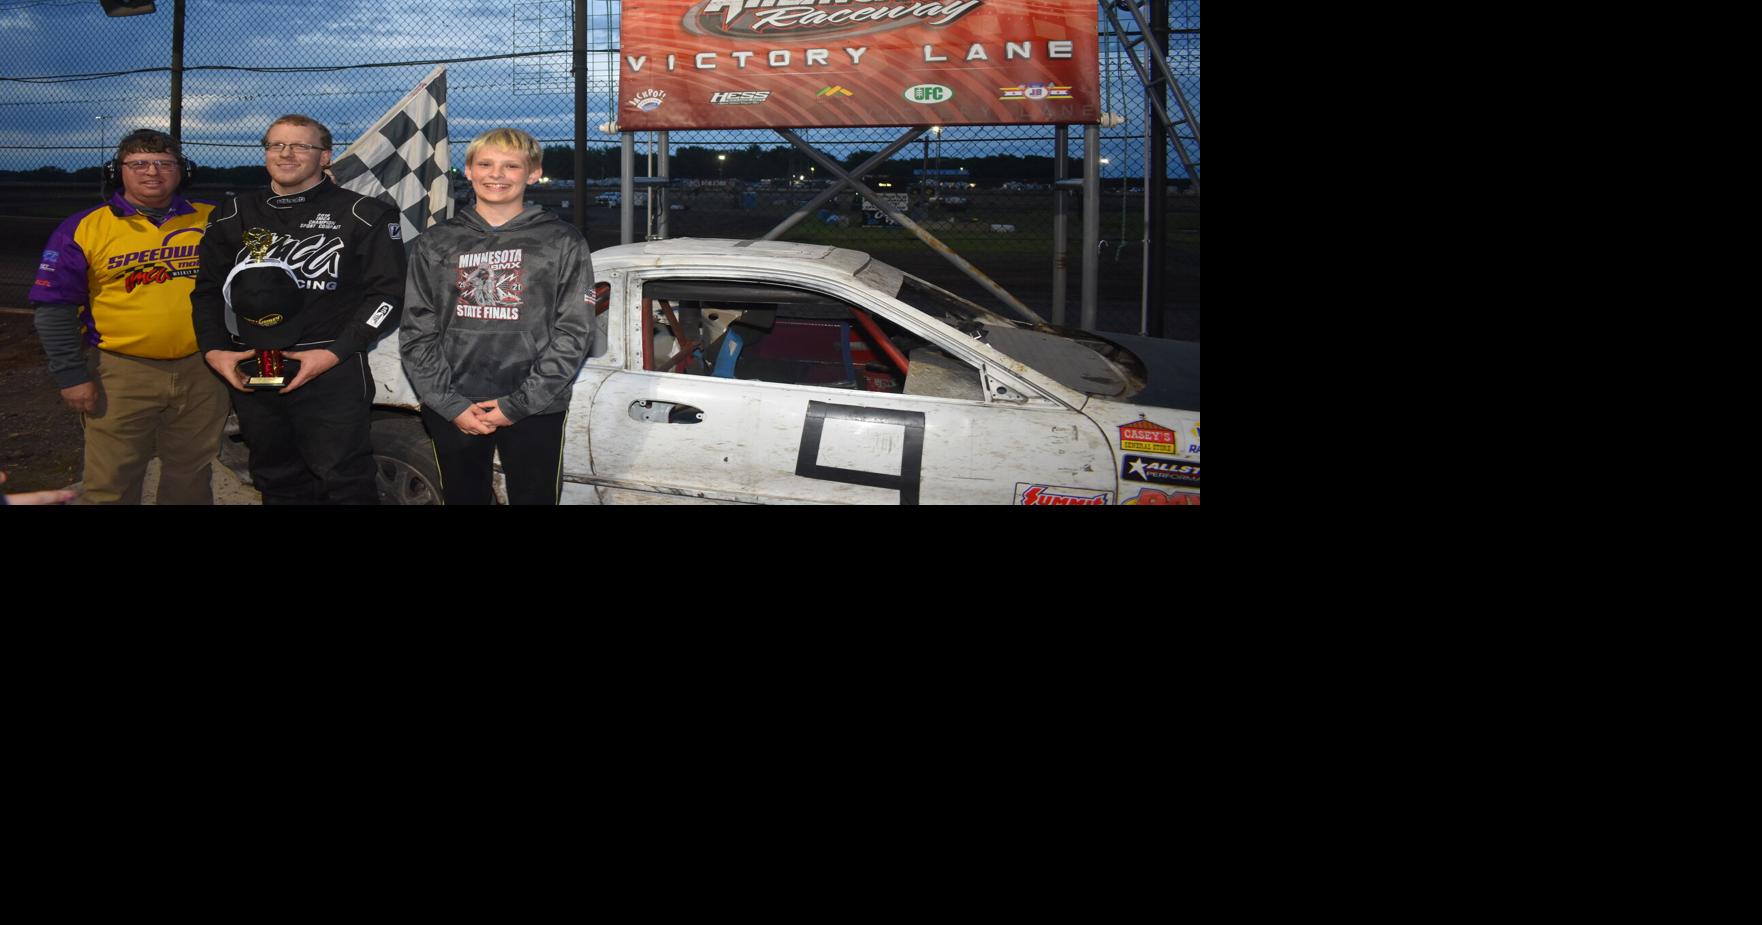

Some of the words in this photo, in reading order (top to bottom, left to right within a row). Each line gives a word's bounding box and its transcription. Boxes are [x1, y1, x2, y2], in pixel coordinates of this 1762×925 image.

[752, 0, 979, 31] Raceway
[626, 47, 866, 71] VICTORY
[924, 41, 1073, 62] LANE
[710, 91, 770, 103] HESS
[107, 245, 200, 270] SPEEDW
[459, 249, 522, 268] MINNESOTA
[491, 262, 520, 270] BMX
[297, 279, 337, 291] CING
[457, 305, 482, 318] STATE
[484, 306, 519, 320] FINALS
[1146, 462, 1200, 474] ALLST
[1146, 471, 1200, 480] PERFORM
